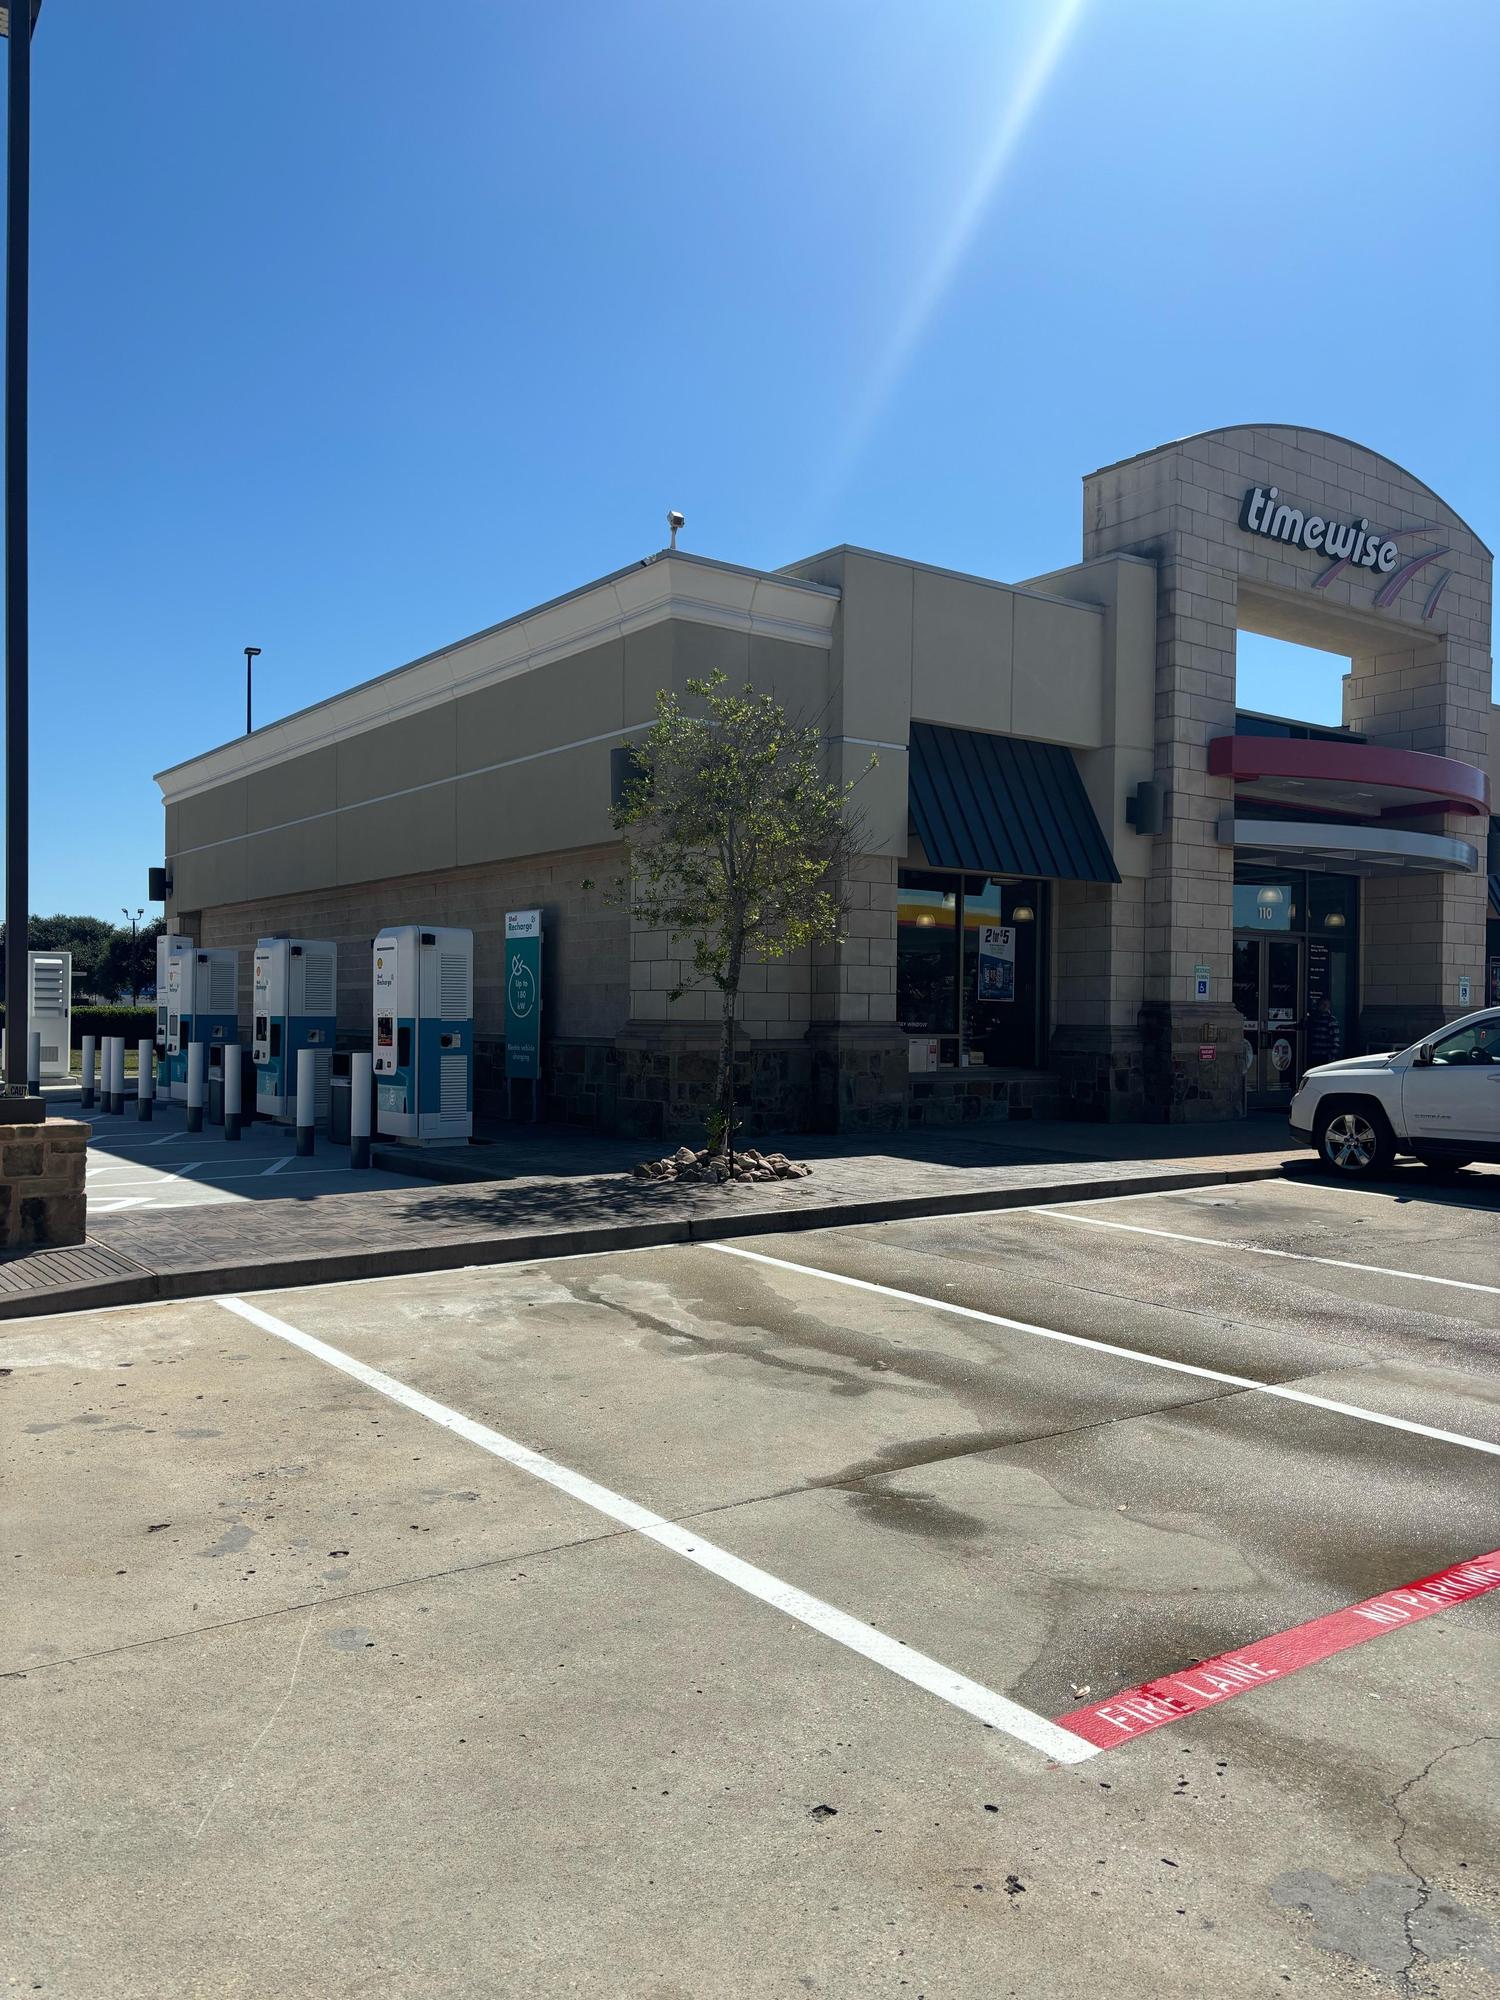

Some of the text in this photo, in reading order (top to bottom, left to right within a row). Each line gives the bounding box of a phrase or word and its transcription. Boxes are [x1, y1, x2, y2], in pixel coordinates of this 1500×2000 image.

[1242, 486, 1398, 573] timewise
[1258, 906, 1272, 920] 110
[508, 922, 533, 932] Recharge
[985, 929, 993, 943] 2
[999, 929, 1010, 944] $5
[515, 979, 522, 989] Up
[1353, 1566, 1500, 1625] NO PARKING
[1095, 1655, 1280, 1732] FIRE LANE
